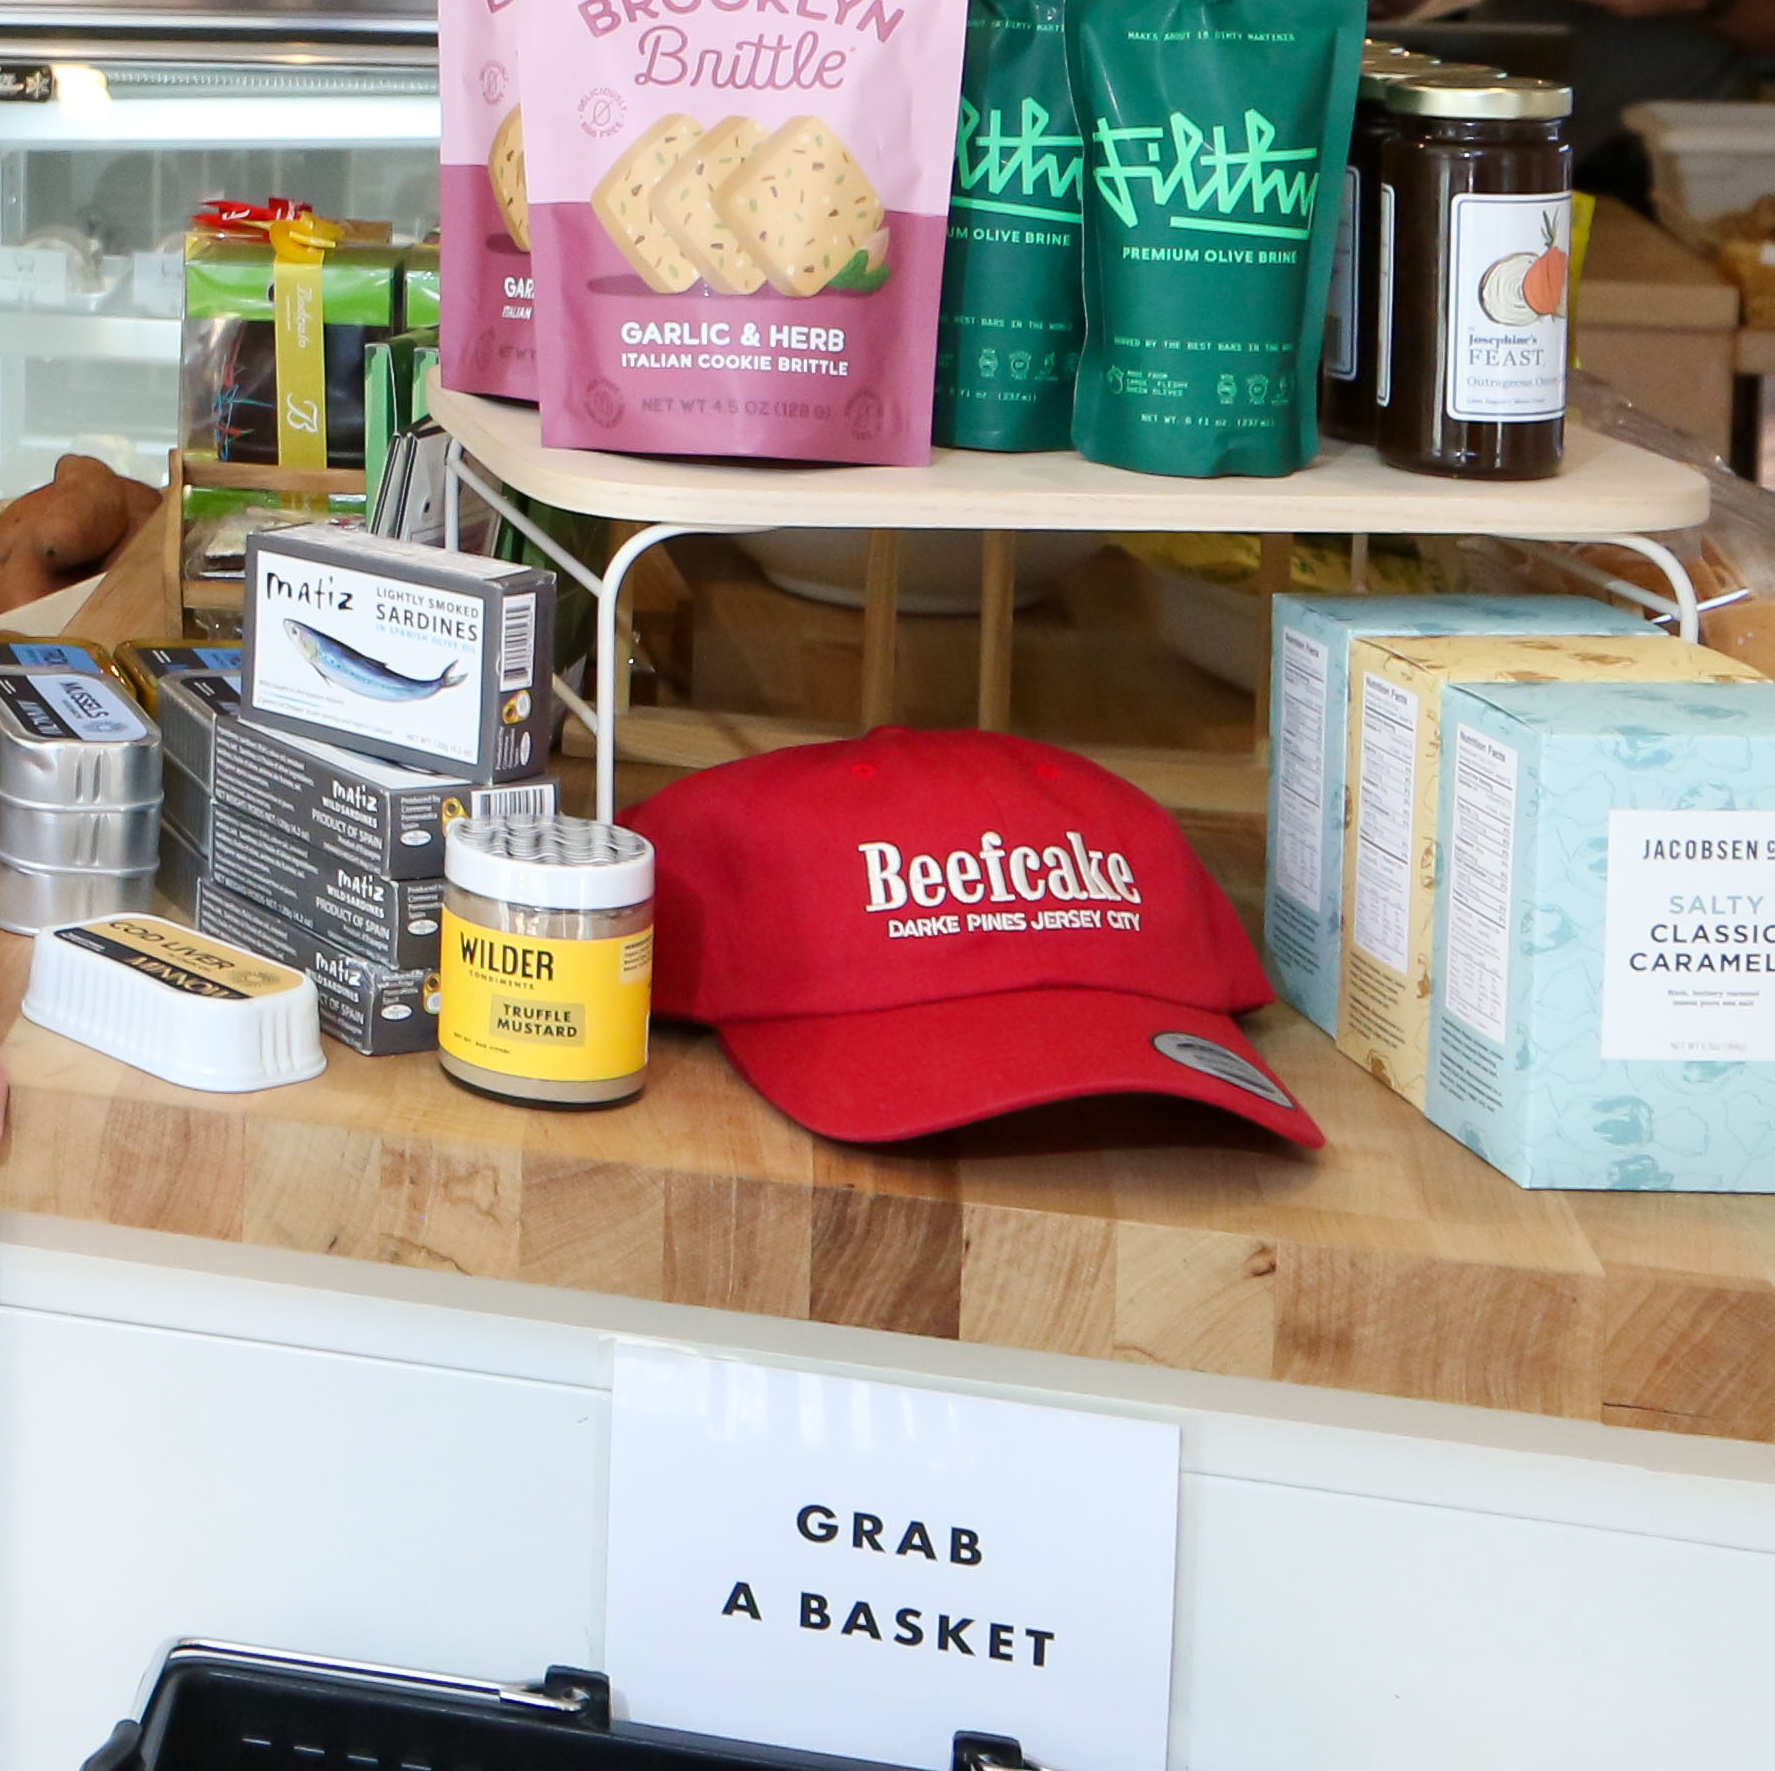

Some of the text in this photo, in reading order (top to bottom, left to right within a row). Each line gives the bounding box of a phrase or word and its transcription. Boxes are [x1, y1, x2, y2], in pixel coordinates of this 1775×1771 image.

[634, 24, 848, 91] Brittle
[973, 228, 1021, 244] OLIVE
[1024, 231, 1071, 248] BRINE
[1122, 246, 1298, 265] PREMIUM OLIVE BRINE
[620, 321, 846, 352] GARLIC & HERB
[621, 353, 849, 377] ITALIAN COOKIE BRITTLE
[1468, 349, 1546, 367] FEAST
[641, 397, 675, 413] NET
[680, 398, 710, 414] WT
[745, 400, 772, 416] OZ
[376, 586, 480, 619] LIGHTLY SMOKED
[376, 603, 479, 642] SARDINES
[1642, 838, 1759, 862] JACOBSEN
[858, 830, 1142, 913] Beefcake
[1668, 894, 1765, 915] SALTY
[888, 909, 1142, 939] DARKE PINES JERSEY CITY
[1650, 923, 1775, 945] CLASSIC
[161, 940, 236, 971] LIVER
[459, 931, 555, 983] WILDER
[1629, 951, 1775, 973] CARAMEL
[503, 1003, 573, 1024] TRUFFLE
[496, 1018, 578, 1039] MUSTARD
[795, 1503, 985, 1567] GRAB
[721, 1580, 1056, 1668] A BASKET
